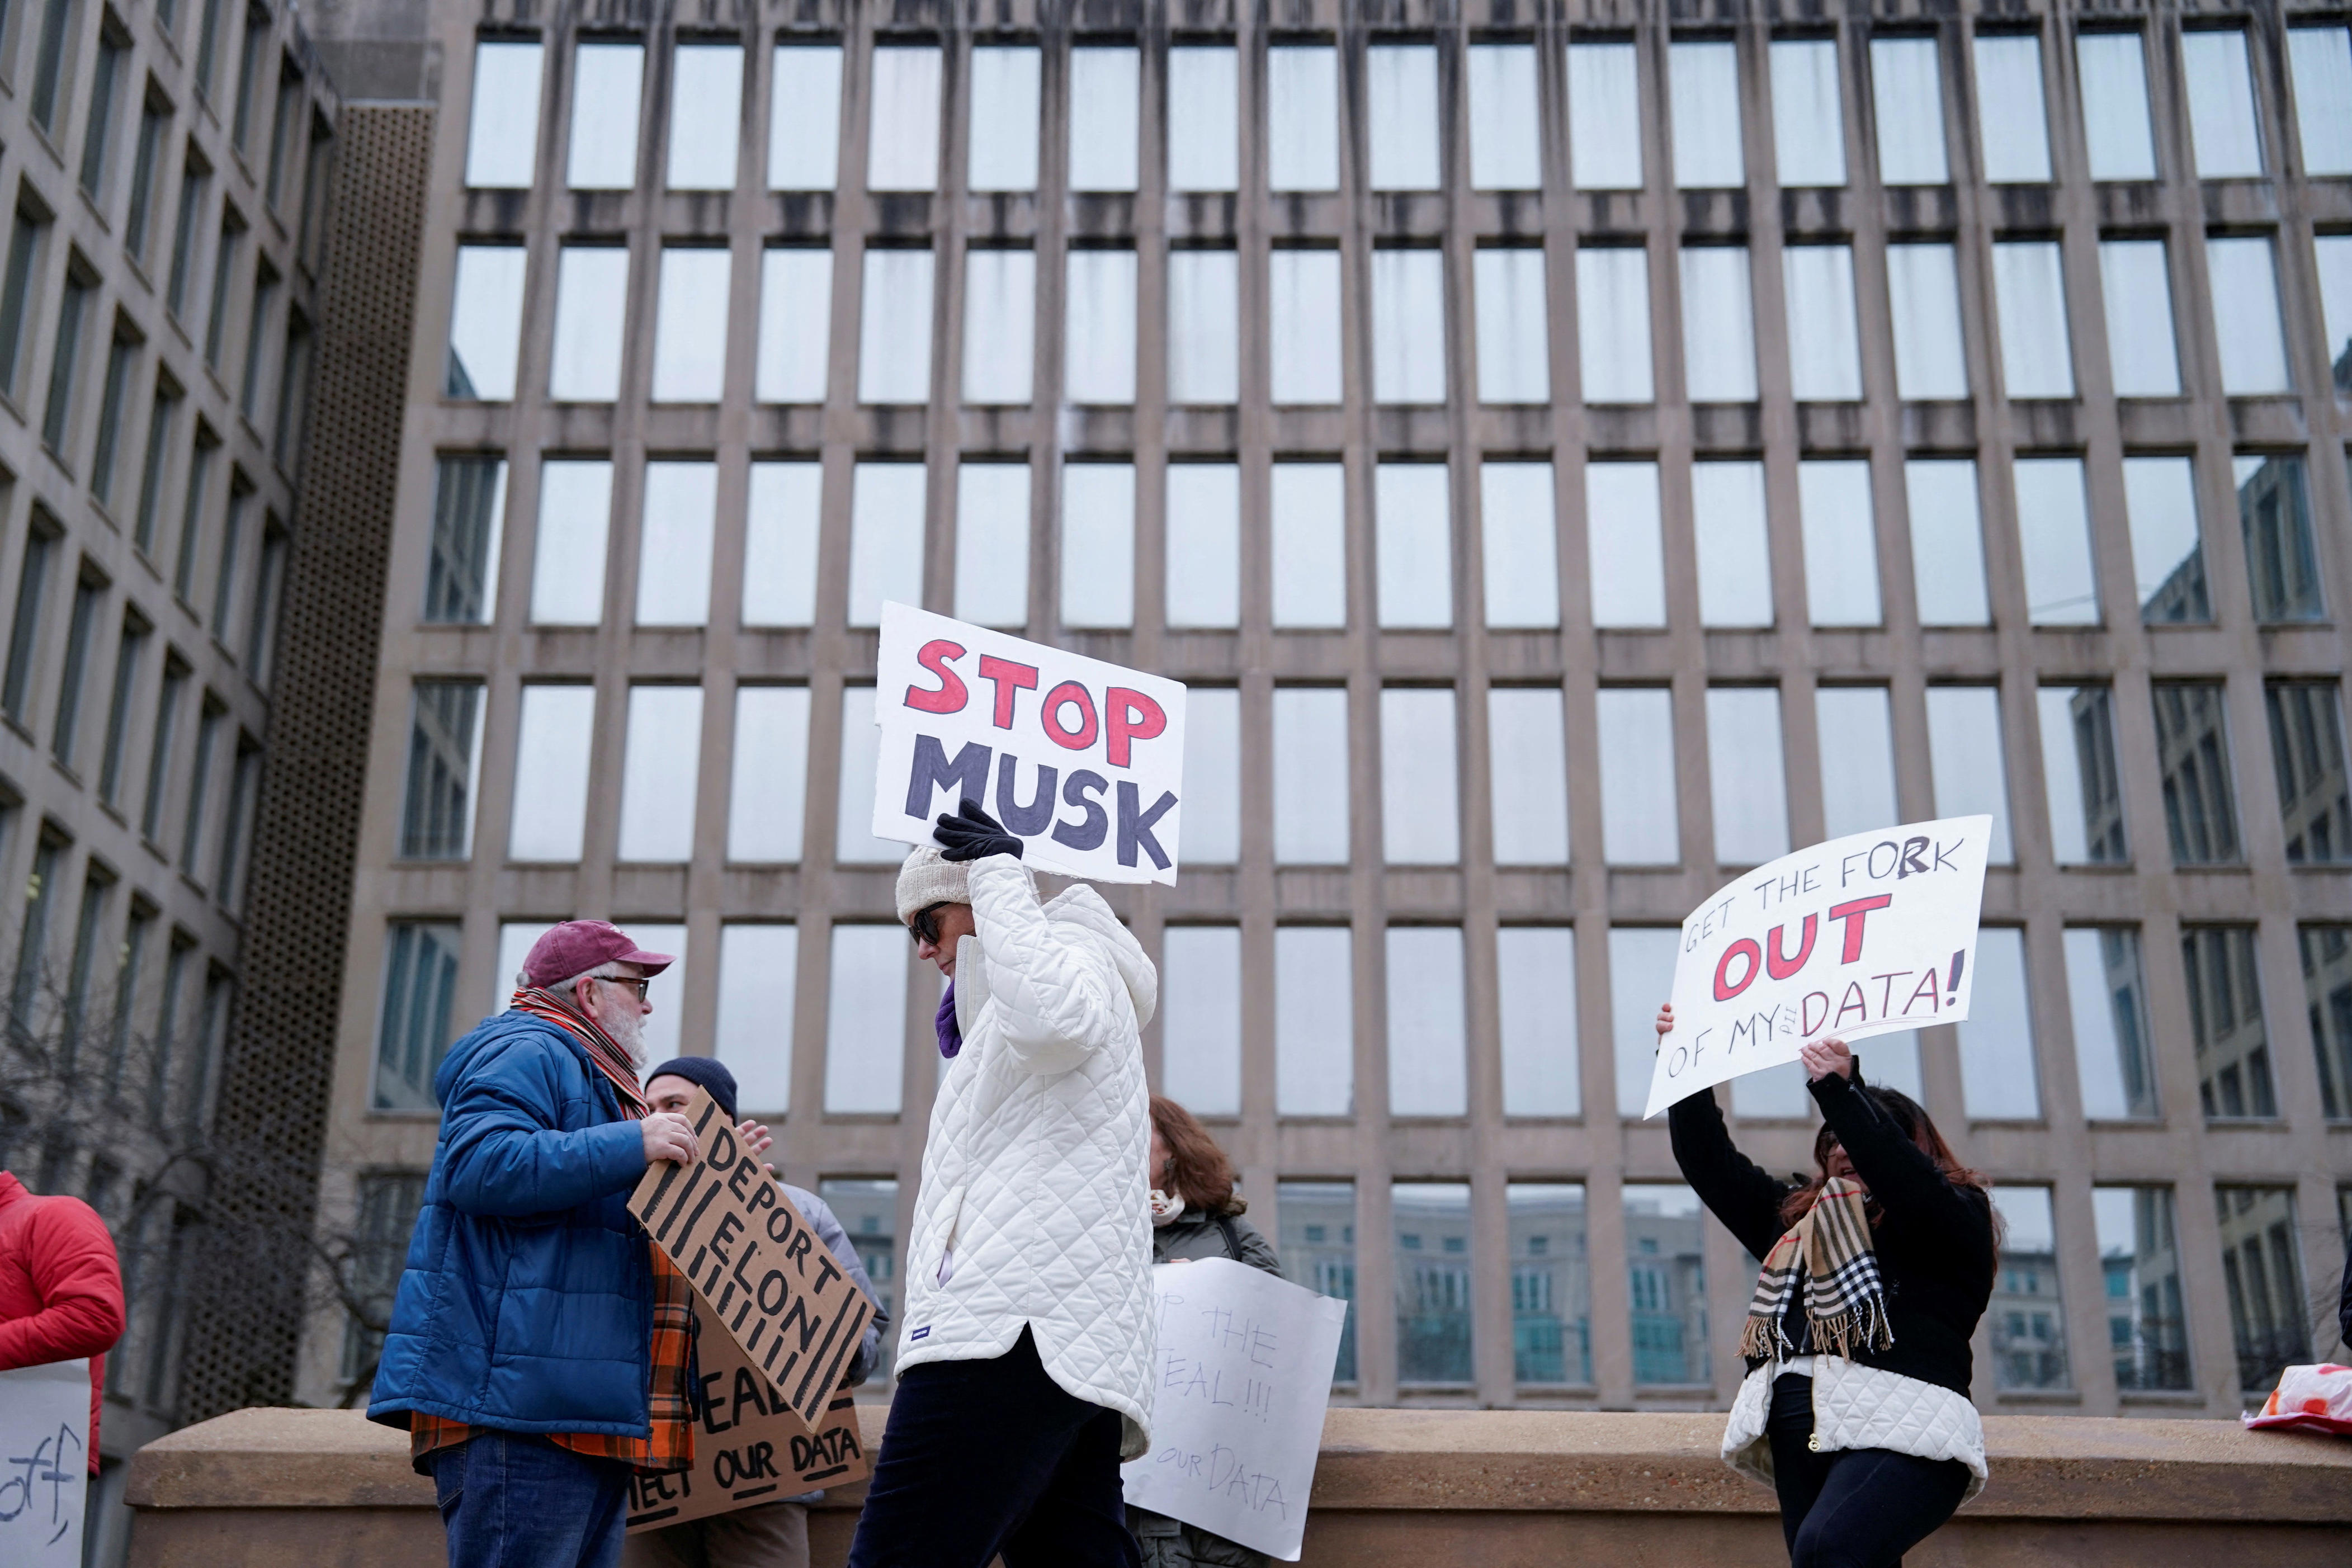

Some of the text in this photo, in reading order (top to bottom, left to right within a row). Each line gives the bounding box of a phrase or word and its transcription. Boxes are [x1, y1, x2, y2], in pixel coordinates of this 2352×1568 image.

[903, 639, 1167, 769] STOP
[904, 733, 1179, 871] MUSK
[1685, 835, 1964, 953] GET THE FORK
[1713, 893, 1893, 1002] OUT
[1668, 1027, 1713, 1078] OF
[1728, 1003, 1780, 1055] MY
[1800, 948, 1966, 1038] DATA!
[707, 1125, 842, 1296] DEPORT
[709, 1211, 823, 1354] ELON
[1202, 1305, 1277, 1369] THE
[714, 1441, 782, 1489] OUR
[790, 1427, 861, 1473] DATA
[1156, 1443, 1287, 1521] OUR DATA
